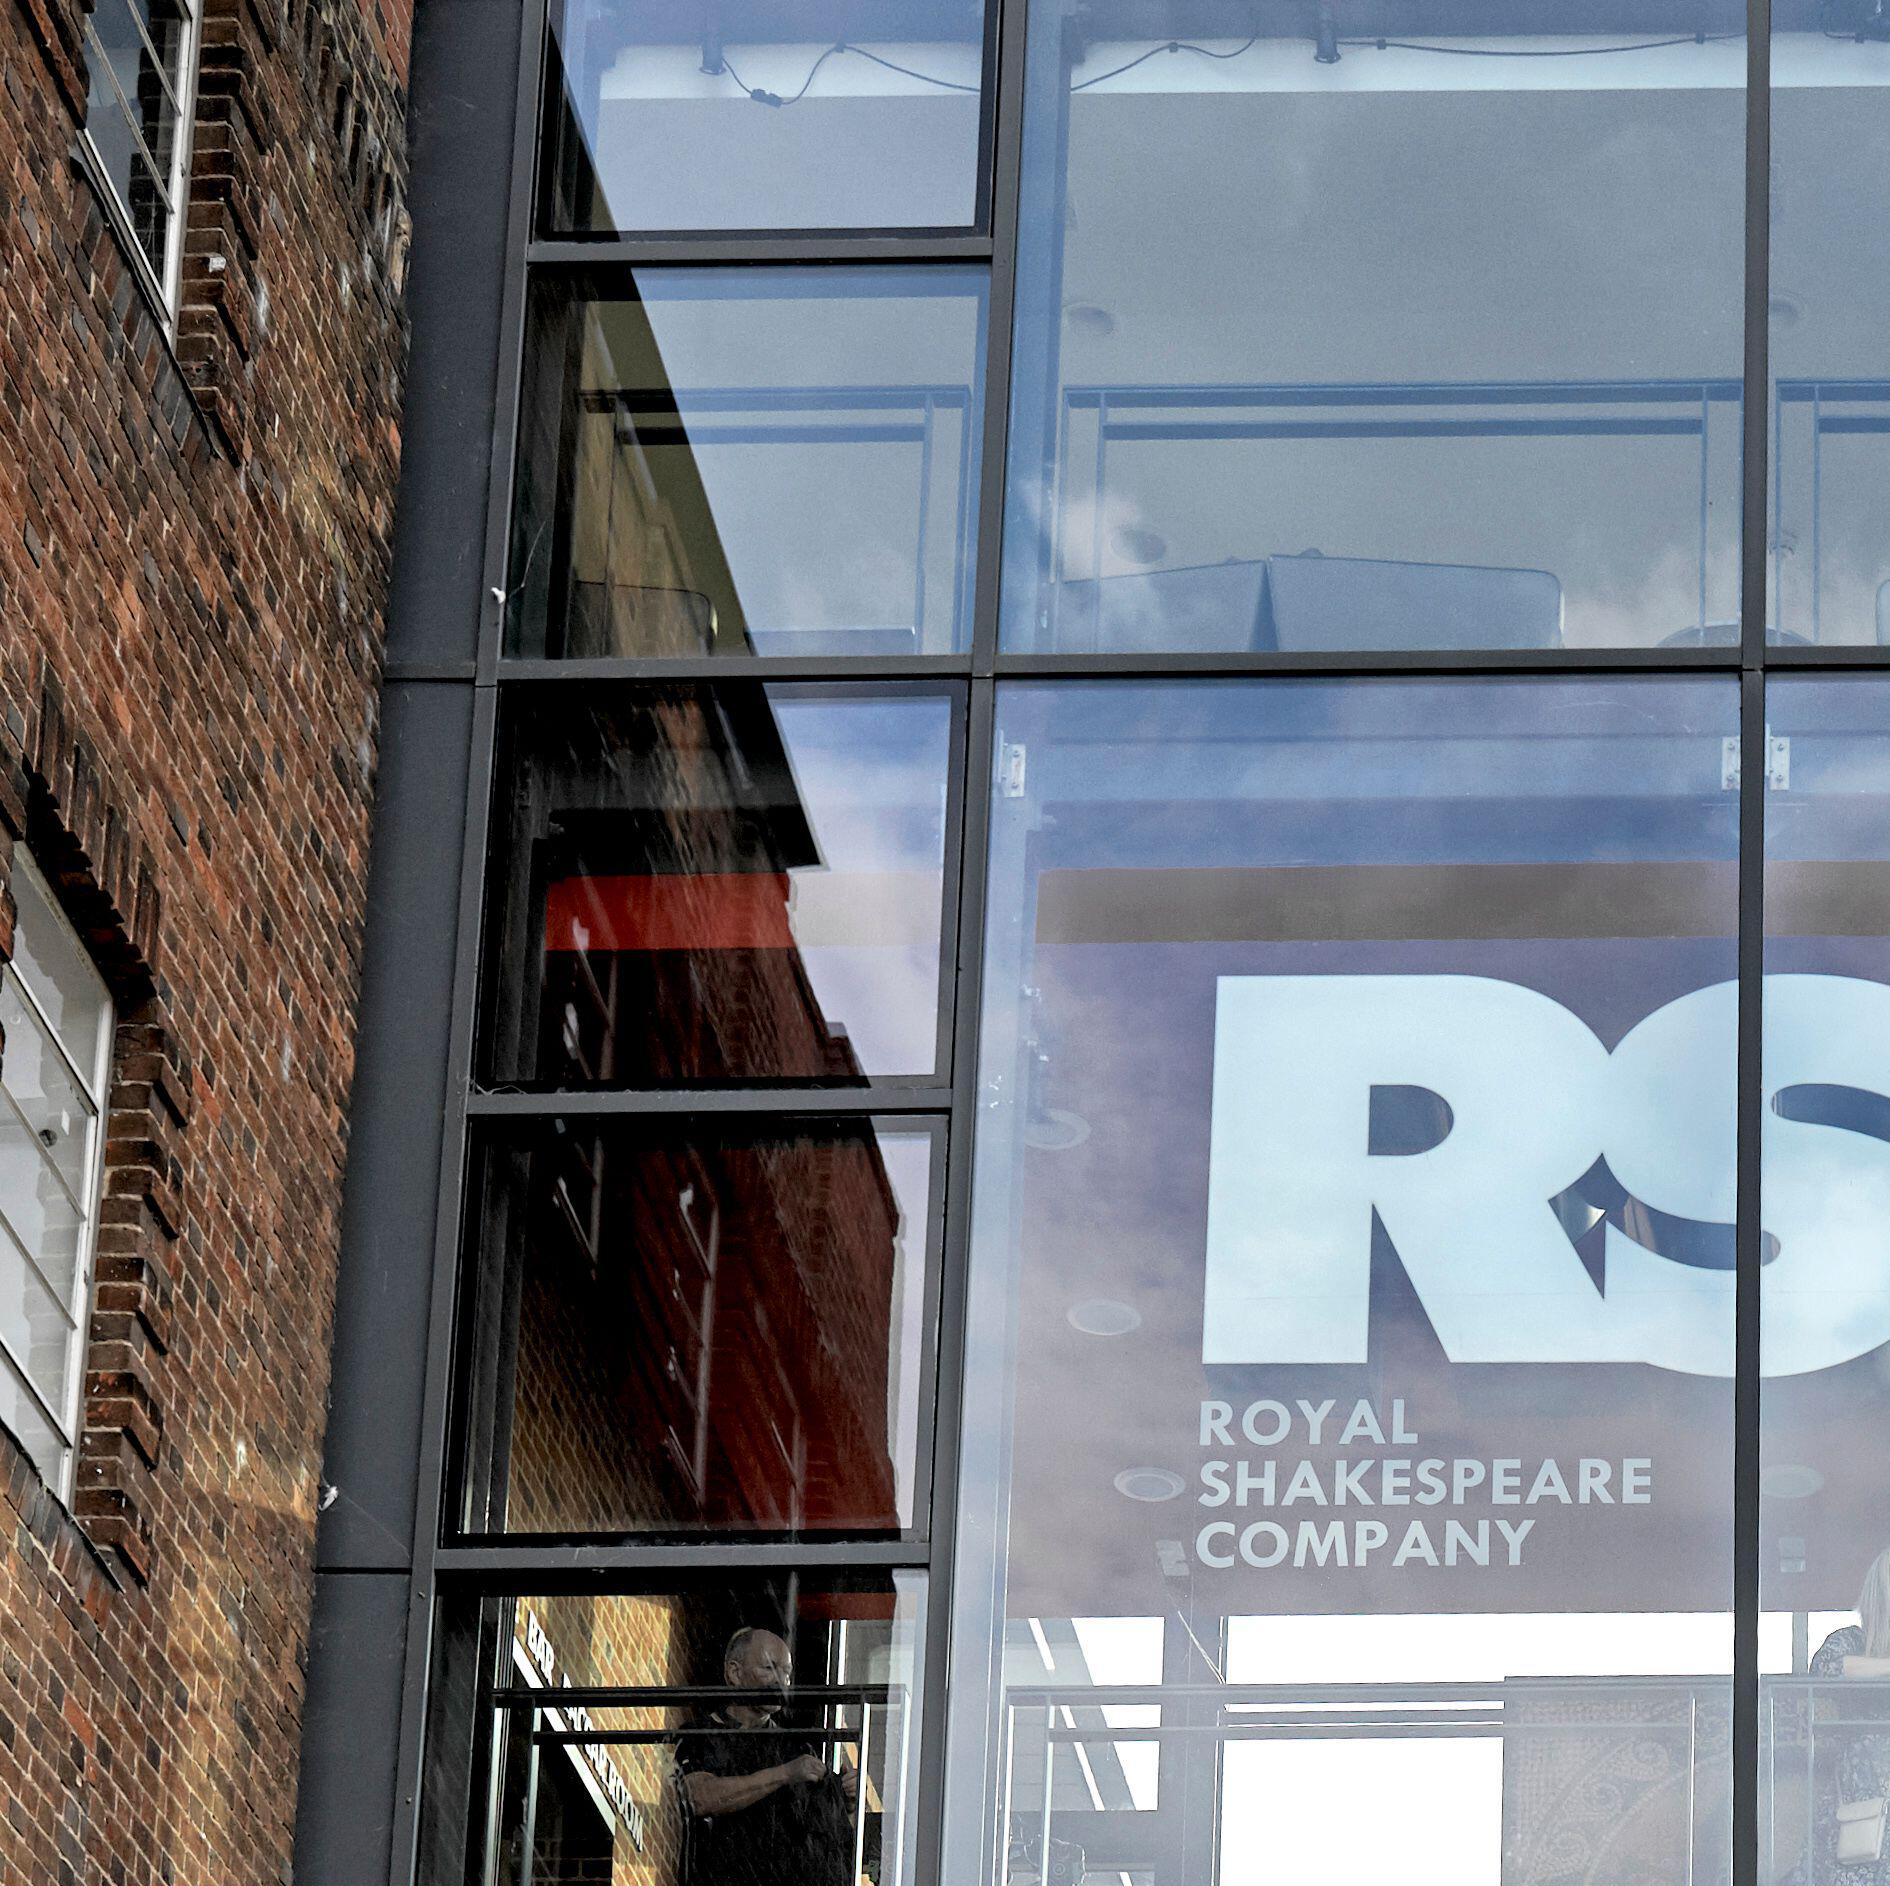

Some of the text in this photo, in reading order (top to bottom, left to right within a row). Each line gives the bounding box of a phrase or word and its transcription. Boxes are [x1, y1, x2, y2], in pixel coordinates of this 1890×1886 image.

[1199, 1399, 1419, 1447] ROYAL
[1198, 1456, 1652, 1507] SHAKESPEARE
[1196, 1517, 1537, 1570] COMPANY
